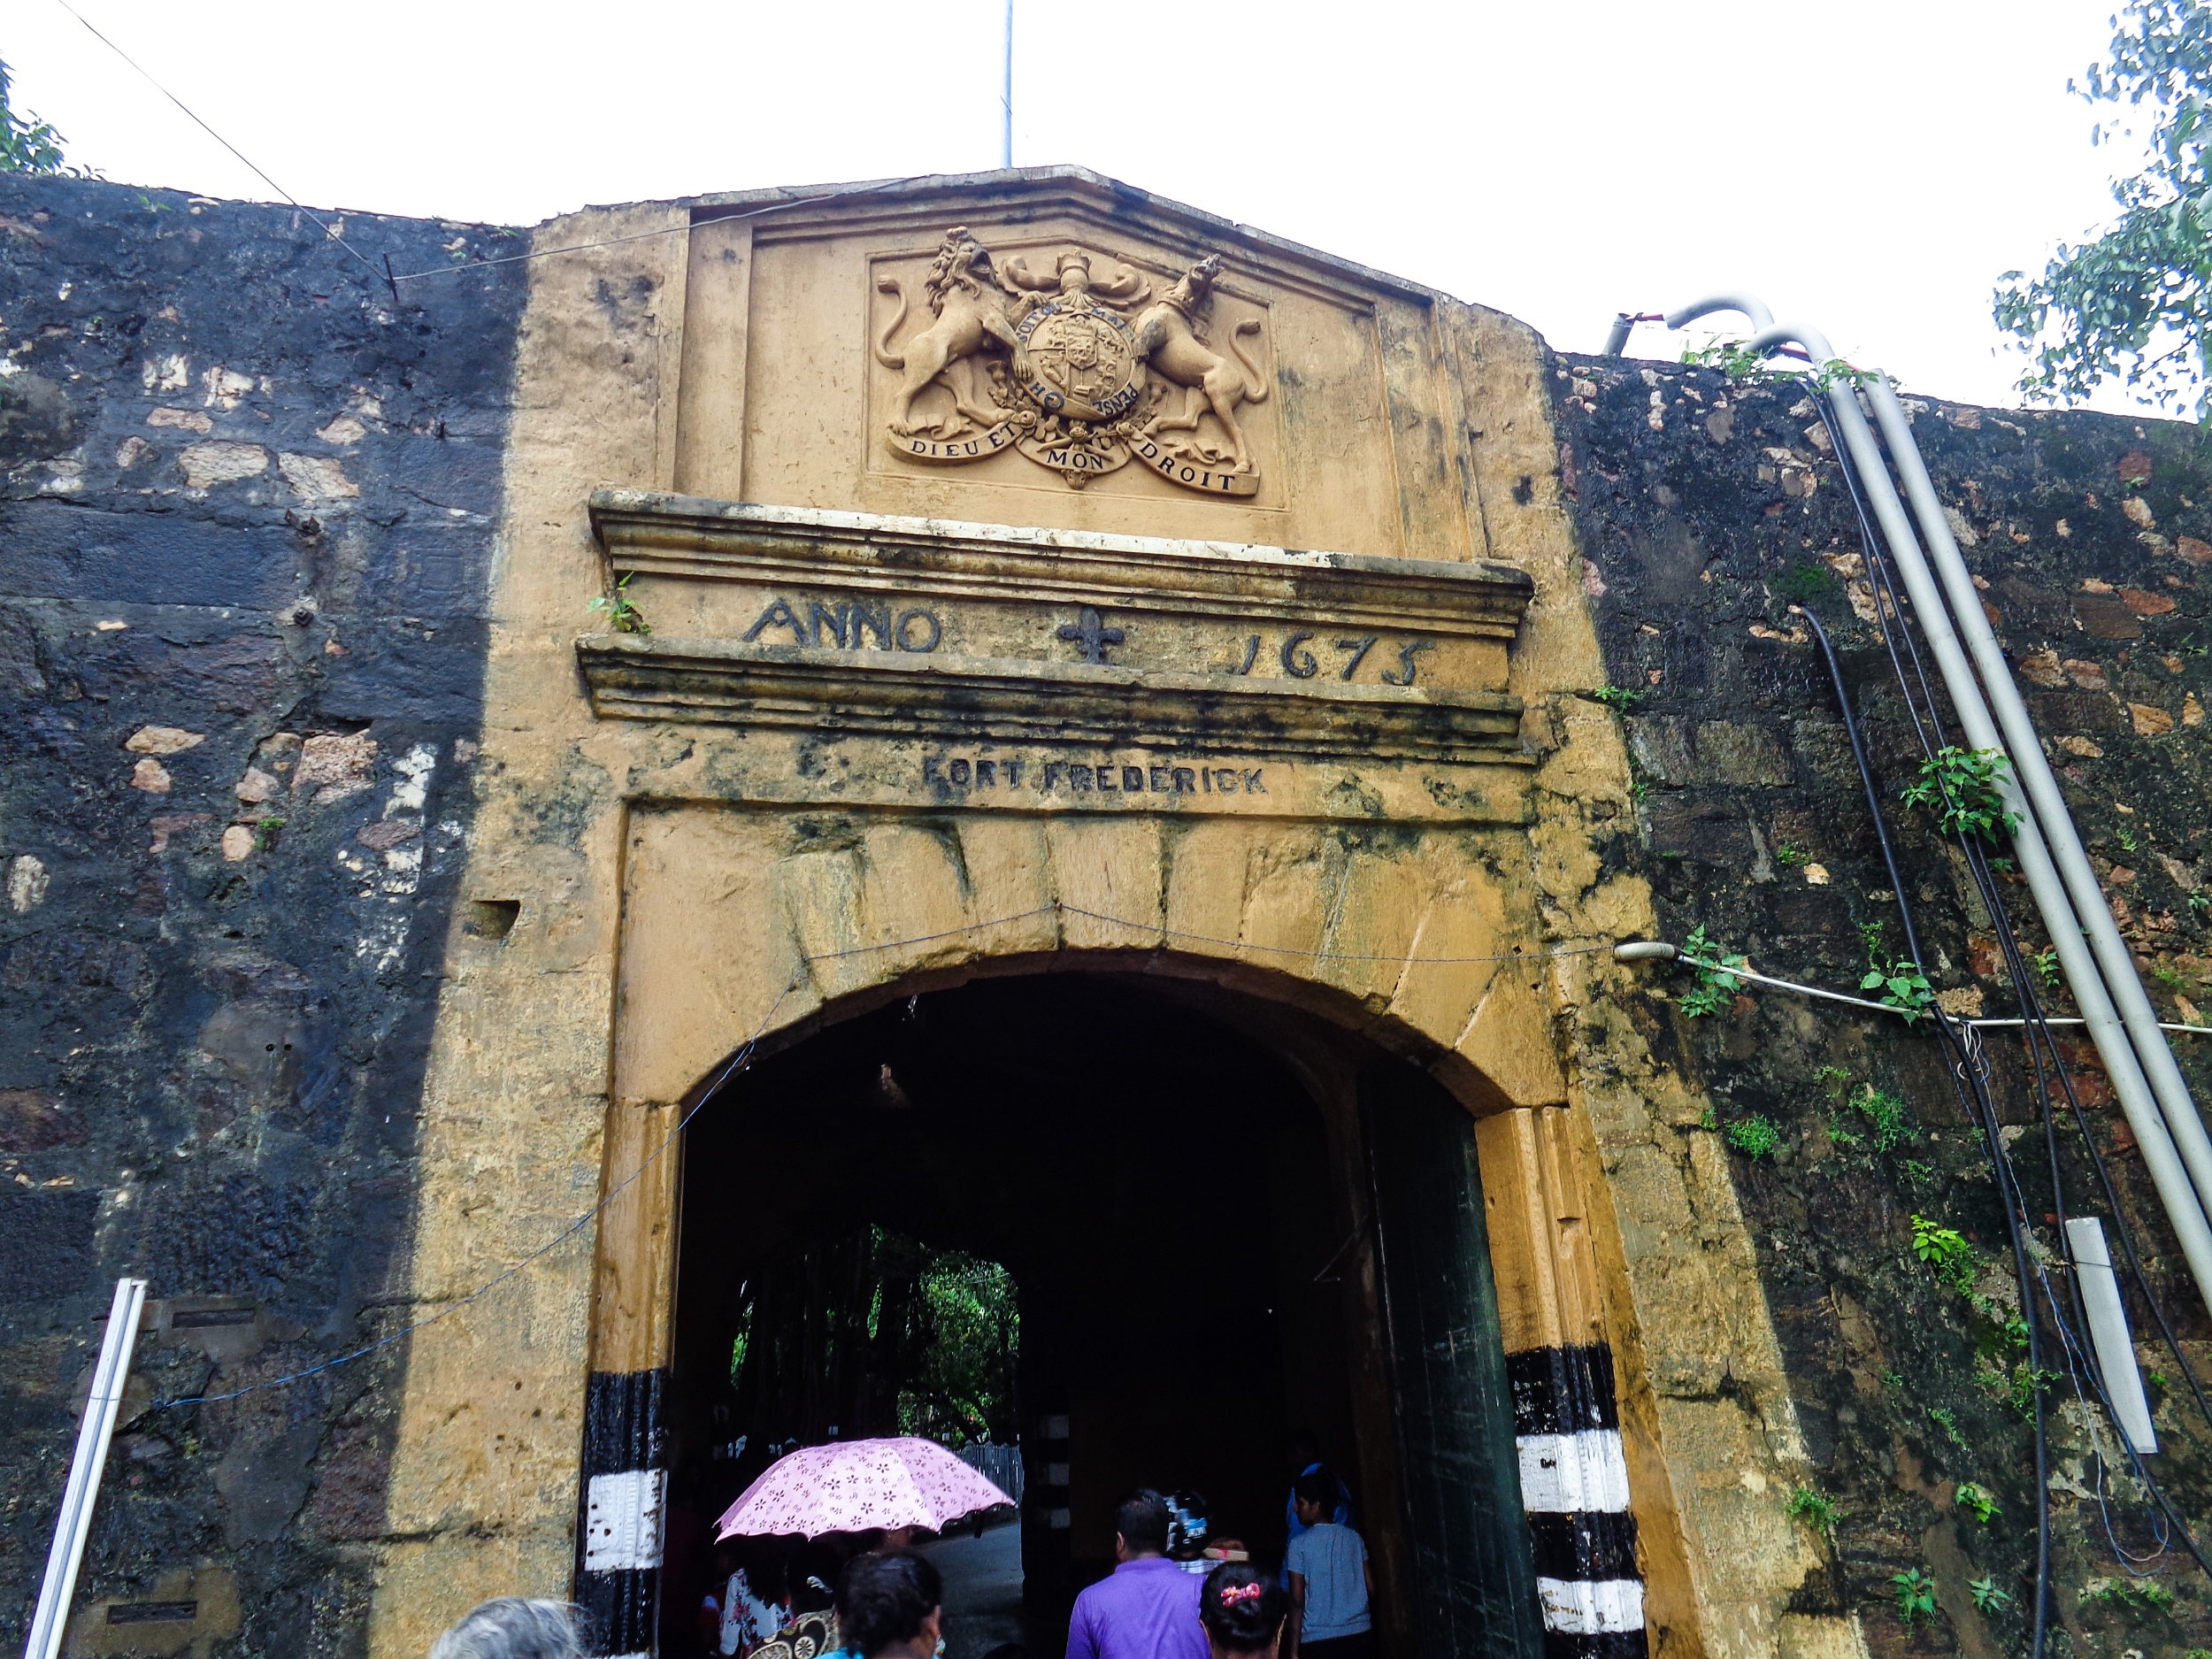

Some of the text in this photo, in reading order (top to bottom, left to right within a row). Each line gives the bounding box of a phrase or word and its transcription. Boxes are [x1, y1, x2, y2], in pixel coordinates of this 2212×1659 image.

[1092, 381, 1139, 415] PENSE
[910, 423, 1235, 491] DIEU ET MON DROIT
[741, 597, 1435, 686] ANNO 1675
[922, 757, 1270, 795] FORT FREDERICK
